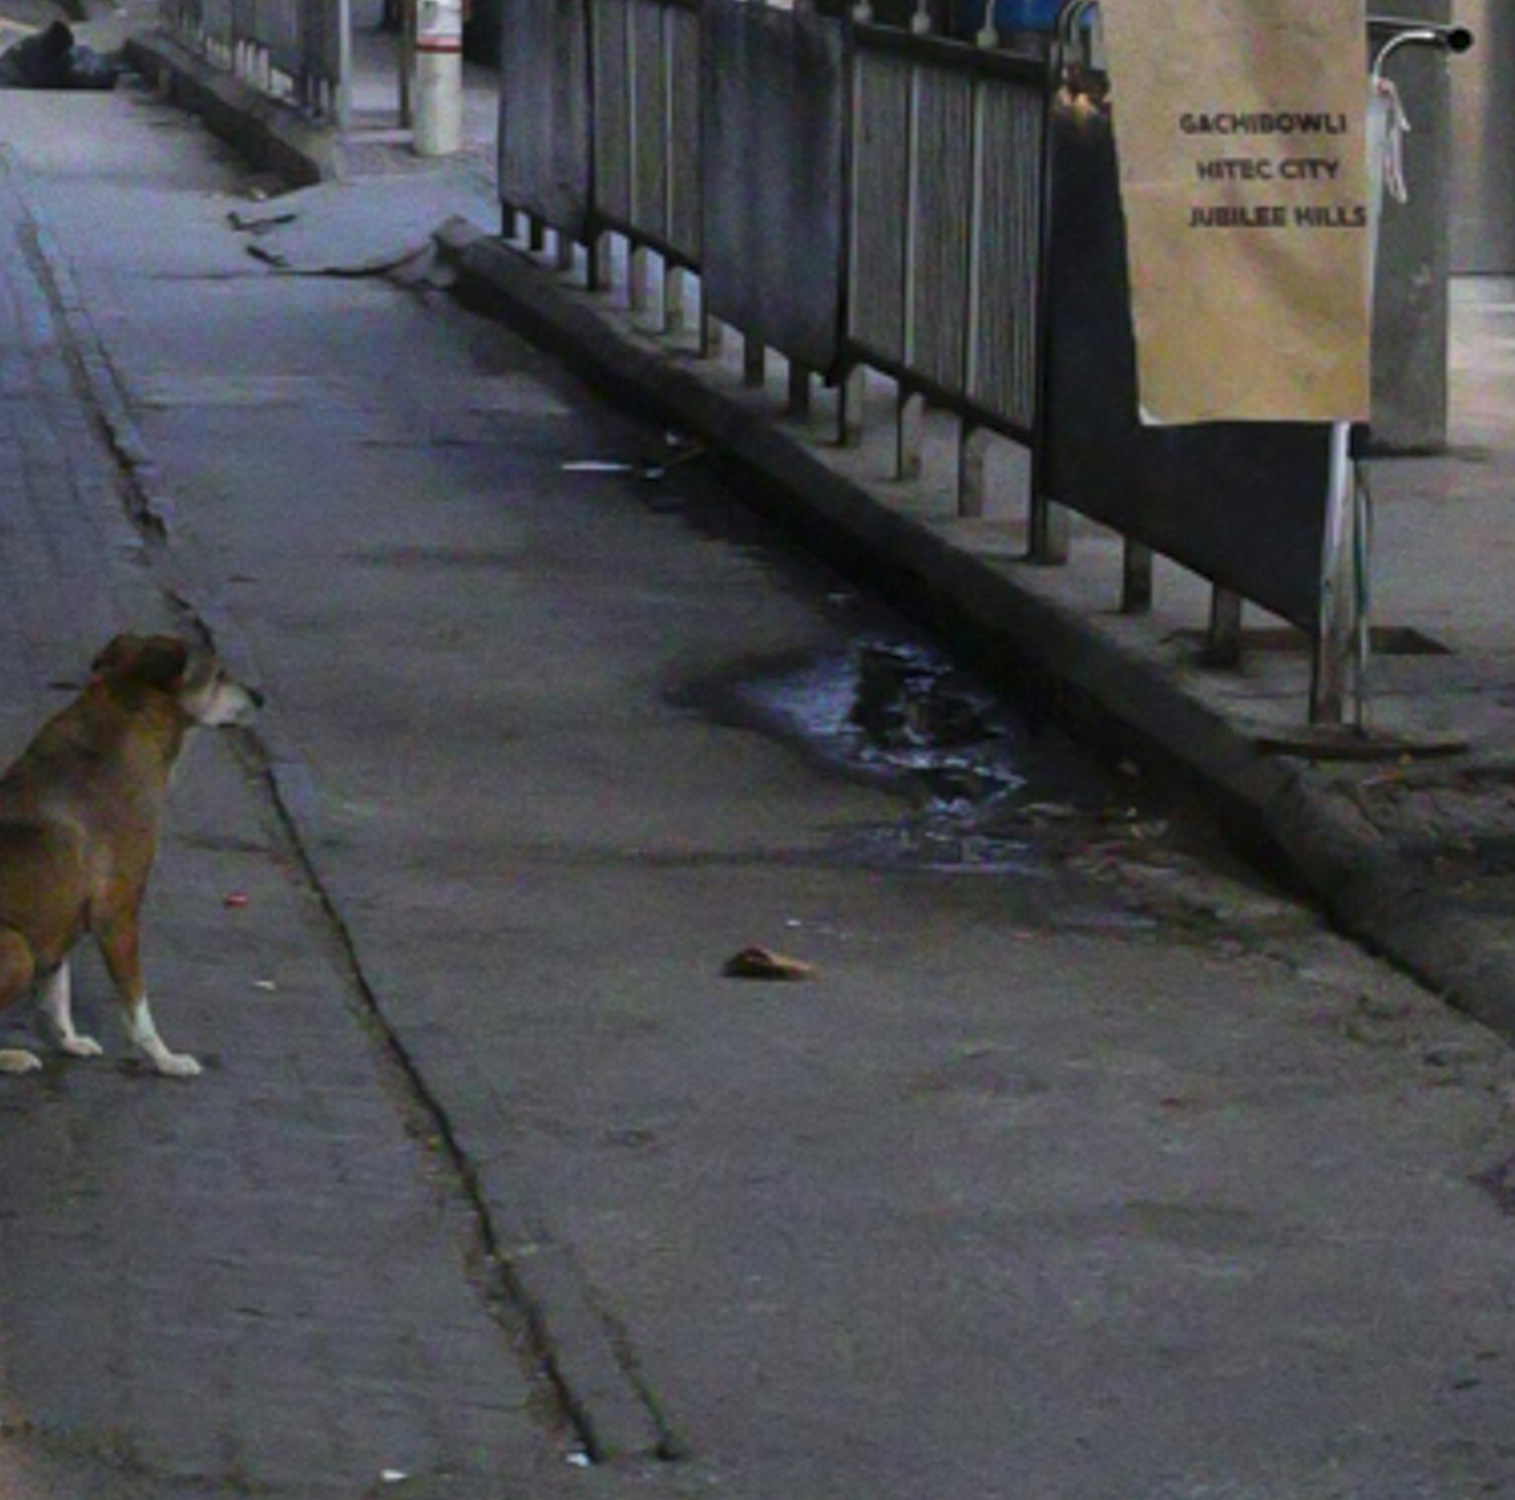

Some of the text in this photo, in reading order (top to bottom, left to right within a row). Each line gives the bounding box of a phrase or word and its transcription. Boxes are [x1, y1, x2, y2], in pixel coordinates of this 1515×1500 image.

[1179, 113, 1347, 135] GACHIBOWLI
[1195, 157, 1340, 181] HITEC CITY
[1187, 205, 1368, 229] JUBILEE HILLS
